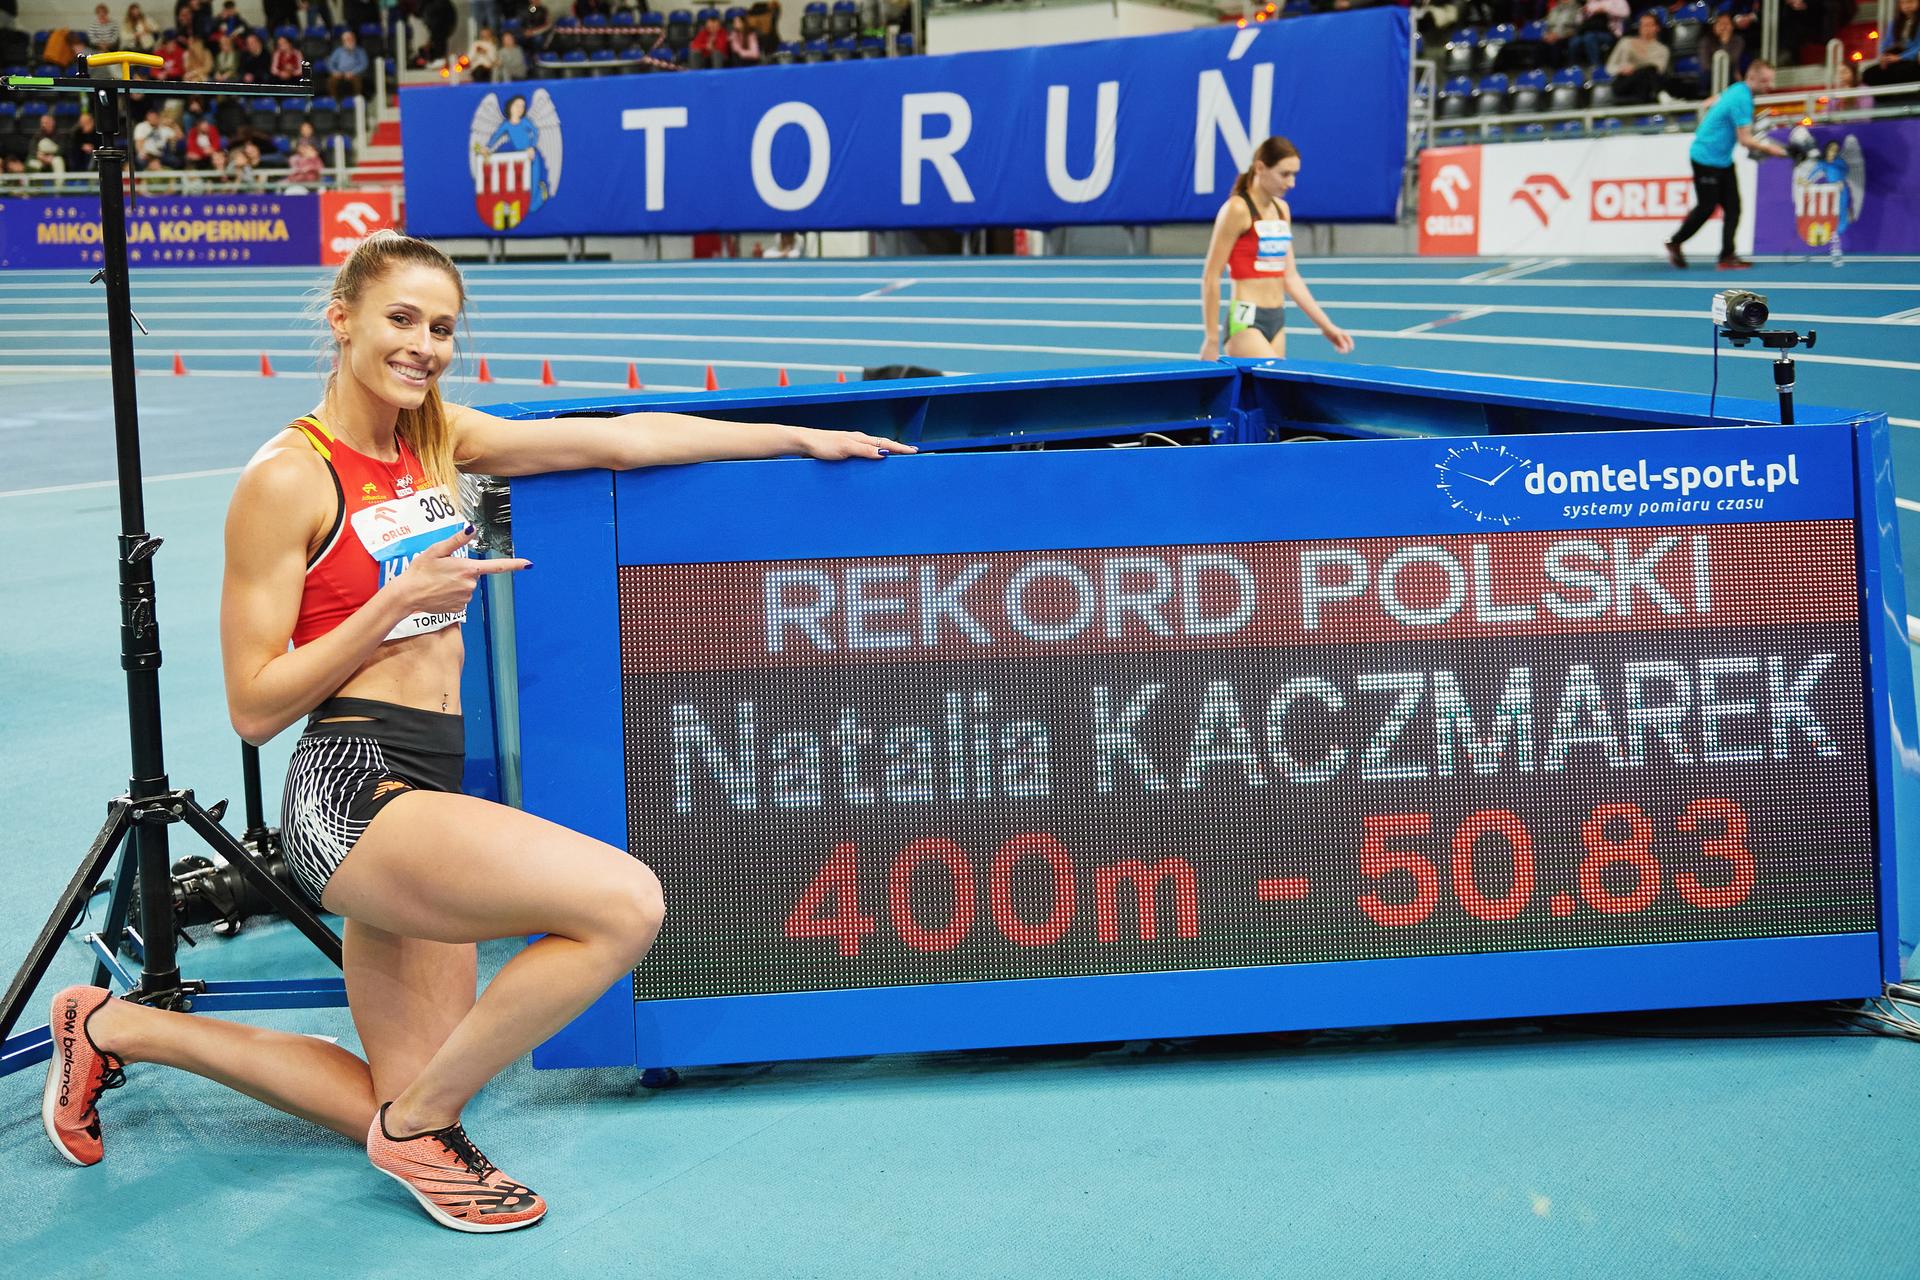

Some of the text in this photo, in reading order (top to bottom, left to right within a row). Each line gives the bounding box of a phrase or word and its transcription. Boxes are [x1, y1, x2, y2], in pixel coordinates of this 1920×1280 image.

[622, 28, 1274, 211] TORUŃ
[37, 219, 289, 245] MIKOJA KOPERNIKA
[1239, 304, 1250, 321] 7
[1525, 454, 1799, 496] domtel-sport.pl
[420, 494, 455, 523] 308
[1562, 496, 1765, 518] systemy pomiaru czasu
[382, 524, 412, 542] ORLEN
[764, 534, 1713, 654] REKORD POLSKI
[672, 652, 1844, 815] Natalia KACZMAREK
[784, 831, 1199, 957] 400m
[1355, 797, 1757, 928] 50.83
[59, 998, 78, 1107] new balance
